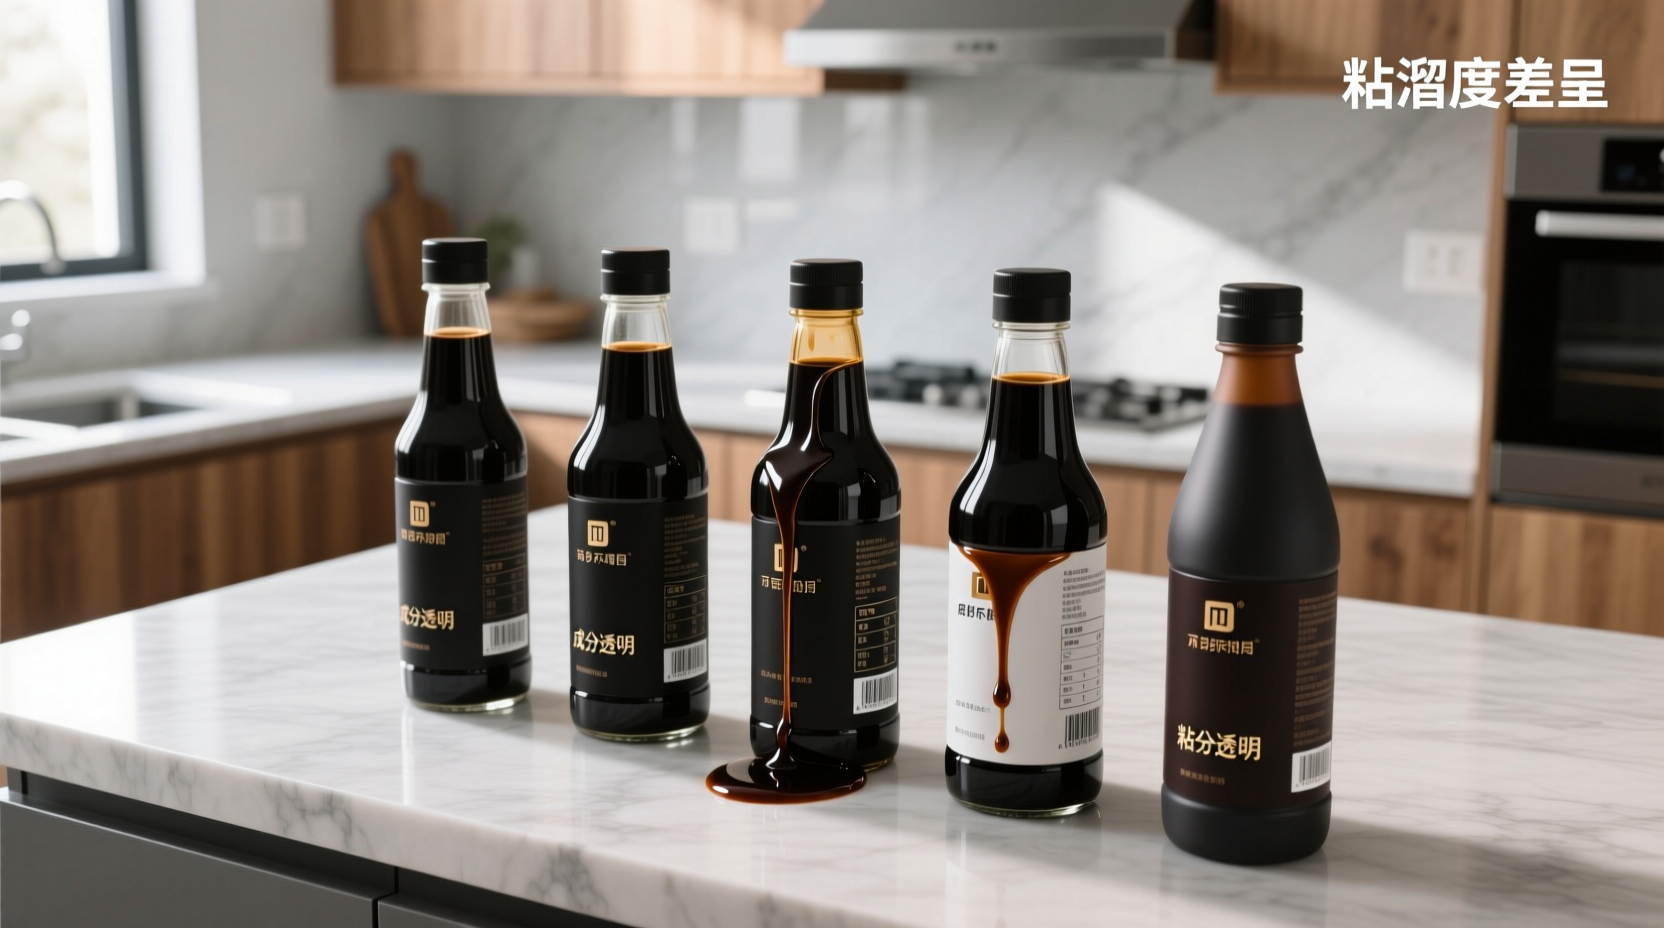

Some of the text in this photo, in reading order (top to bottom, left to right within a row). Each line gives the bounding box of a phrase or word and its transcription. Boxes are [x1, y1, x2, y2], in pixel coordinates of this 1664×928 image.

[573, 628, 635, 656] 成分透明
[1177, 724, 1261, 761] 粘分透明
